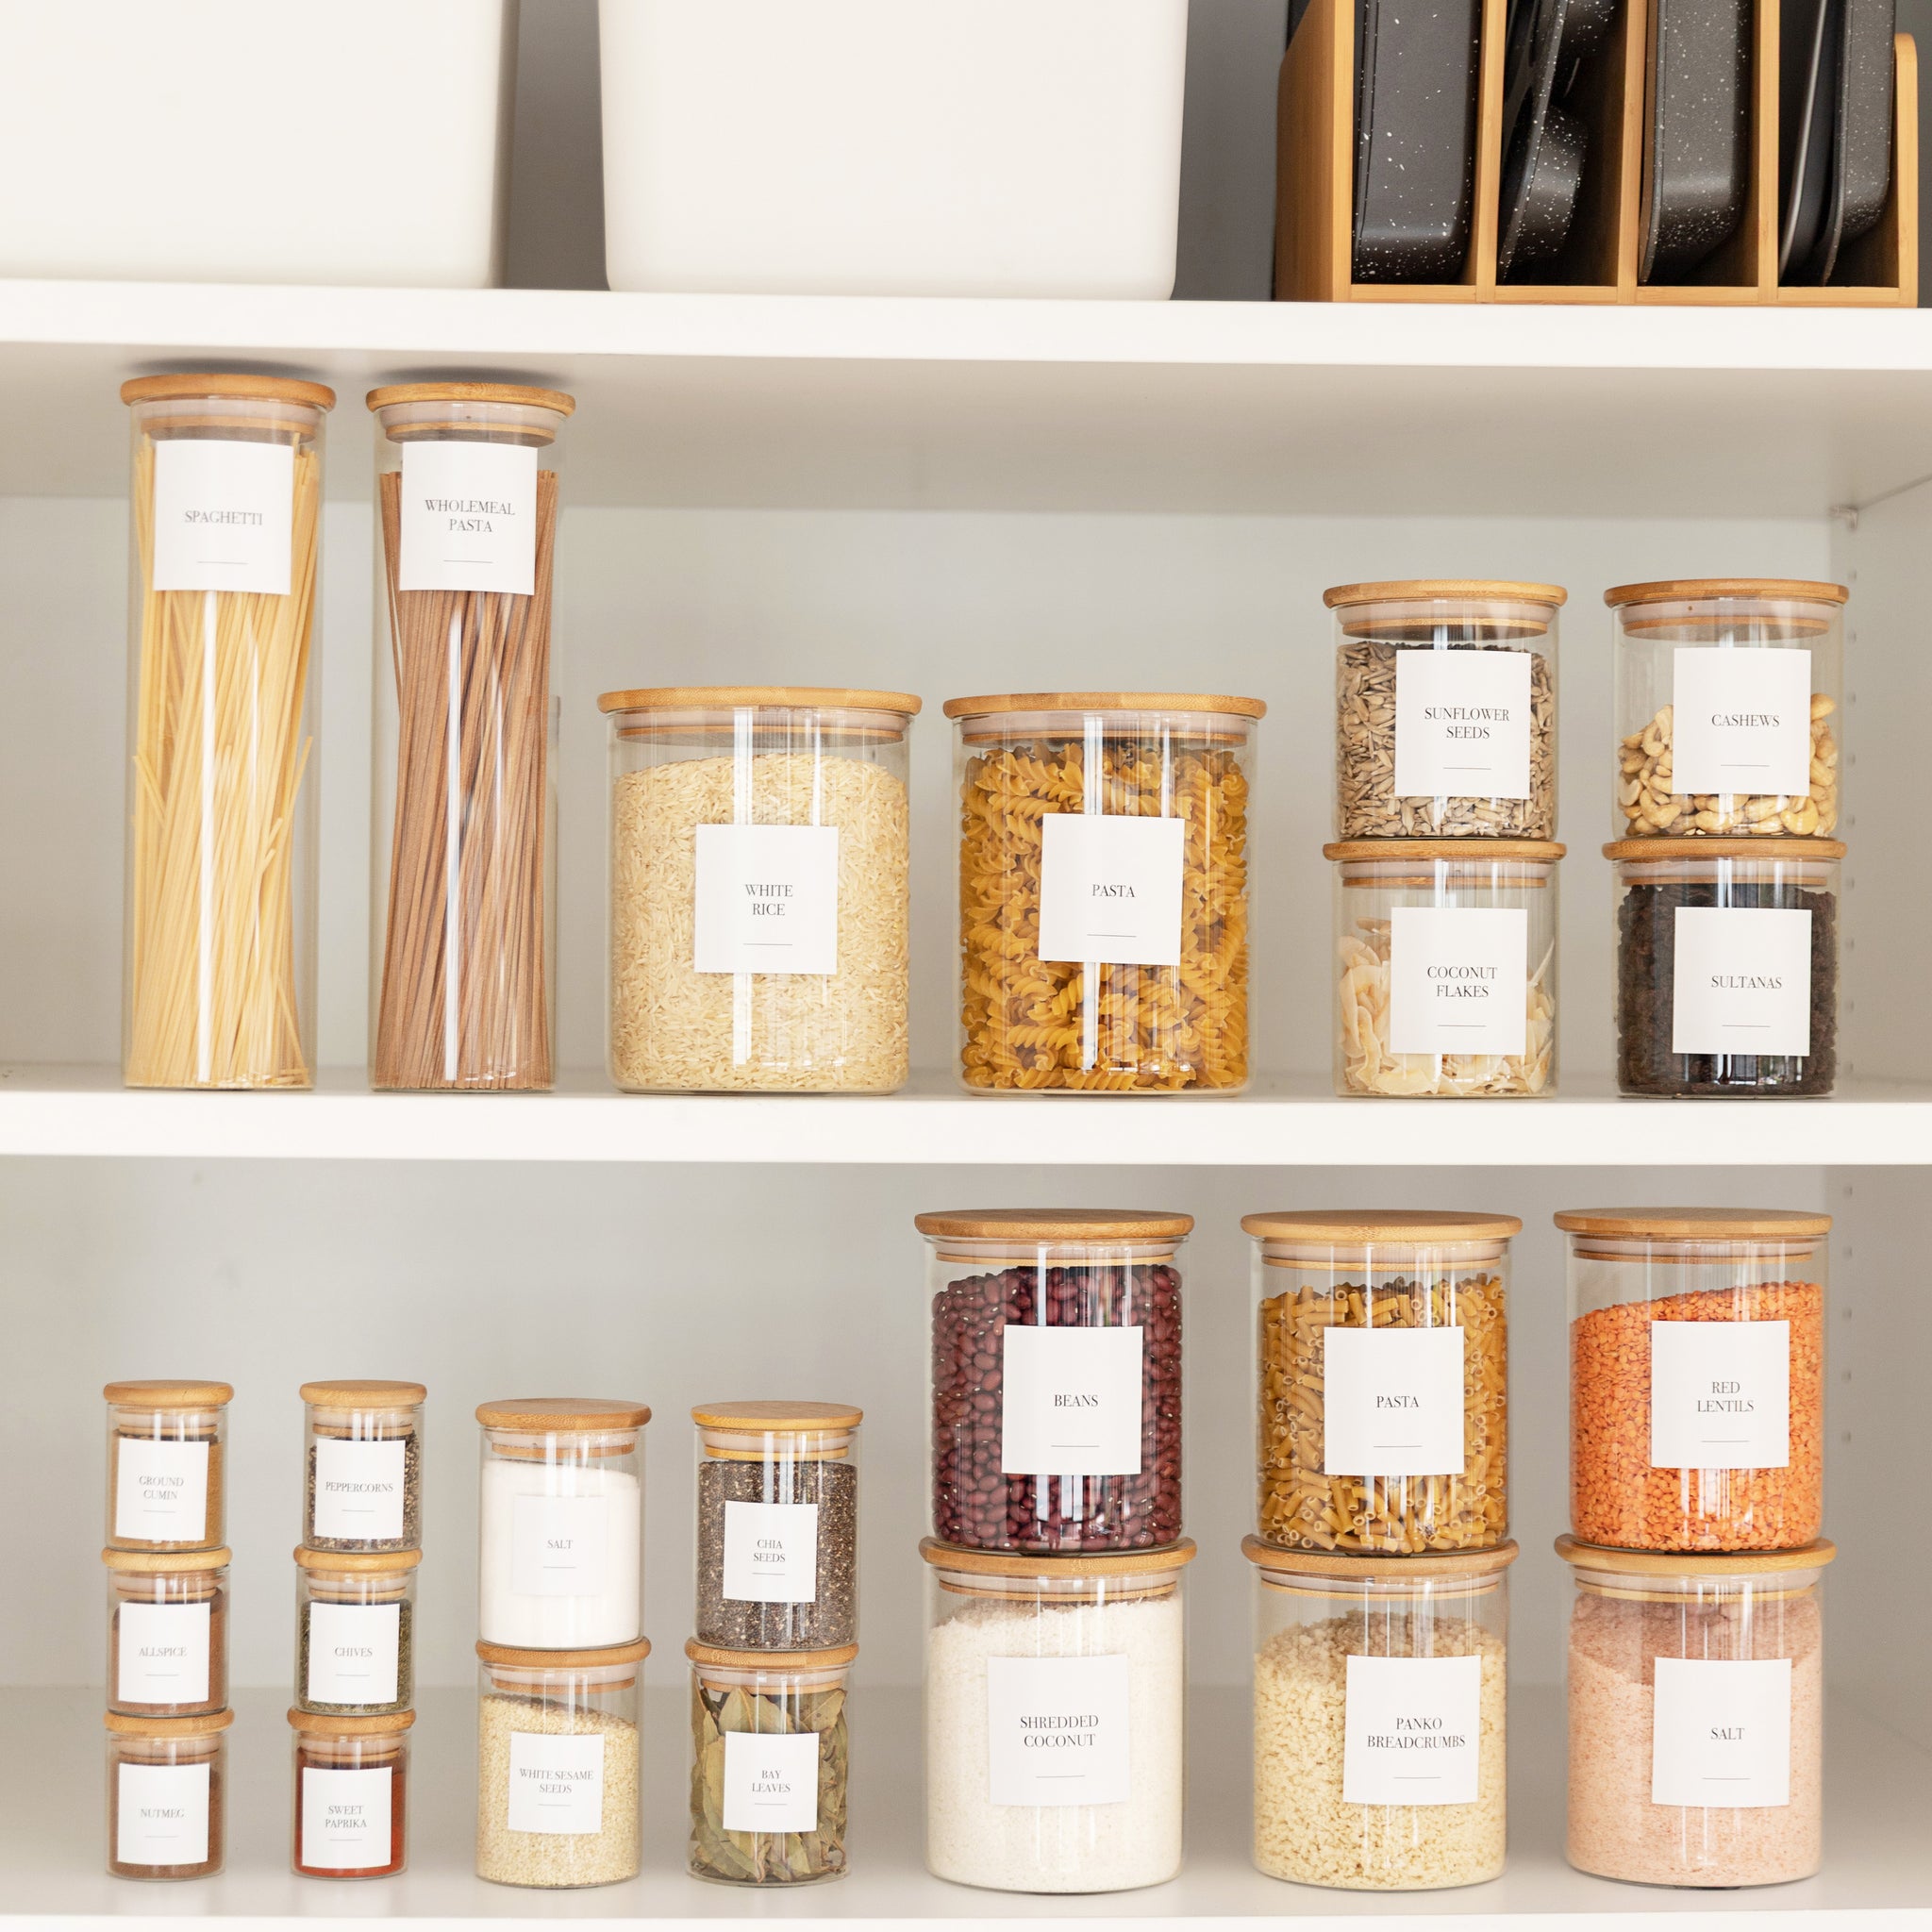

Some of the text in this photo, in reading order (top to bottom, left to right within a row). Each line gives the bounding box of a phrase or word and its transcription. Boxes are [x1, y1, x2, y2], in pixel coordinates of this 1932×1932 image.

[424, 499, 516, 516] WHOLEMEAL
[184, 509, 263, 526] SPAGHETTI
[449, 518, 492, 533] PASTA
[1424, 707, 1510, 722] SUNFLOWER
[1711, 714, 1780, 727] CASHEWS
[1446, 725, 1491, 740] SEEDS
[744, 884, 793, 897] WHITE
[1092, 884, 1136, 898] PASTA
[752, 903, 786, 916] RICE
[1426, 966, 1498, 979] COCONUT
[1710, 975, 1783, 990] SULTANAS
[1437, 984, 1490, 998] FLAKES
[1711, 1381, 1740, 1394] RED
[1054, 1394, 1099, 1407] BEANS
[1376, 1395, 1420, 1408] PASTA
[1697, 1399, 1755, 1413] LENTILS
[138, 1475, 185, 1487] GROUND
[325, 1481, 394, 1493] PEPPERCORNS
[142, 1490, 177, 1501] CUMIN
[547, 1539, 574, 1550] SALT
[757, 1539, 783, 1550] CHIA
[753, 1552, 786, 1563] SEEDS
[138, 1646, 187, 1657] ALLSPICE
[334, 1646, 374, 1657] CHIVES
[1020, 1715, 1099, 1729] SHREDDED
[1396, 1717, 1442, 1730] PANKO
[1710, 1727, 1745, 1740] SALT
[1024, 1733, 1096, 1748] COCONUT
[1367, 1735, 1466, 1749] BREADCRUMBS
[519, 1767, 593, 1781] WHITE SESAME
[761, 1770, 782, 1779] BAY
[539, 1783, 573, 1794] SEEDS
[752, 1782, 791, 1793] LEAVES
[140, 1808, 185, 1819] NUTMEG
[327, 1805, 363, 1815] SWEET
[325, 1818, 368, 1829] PAPRIKA
